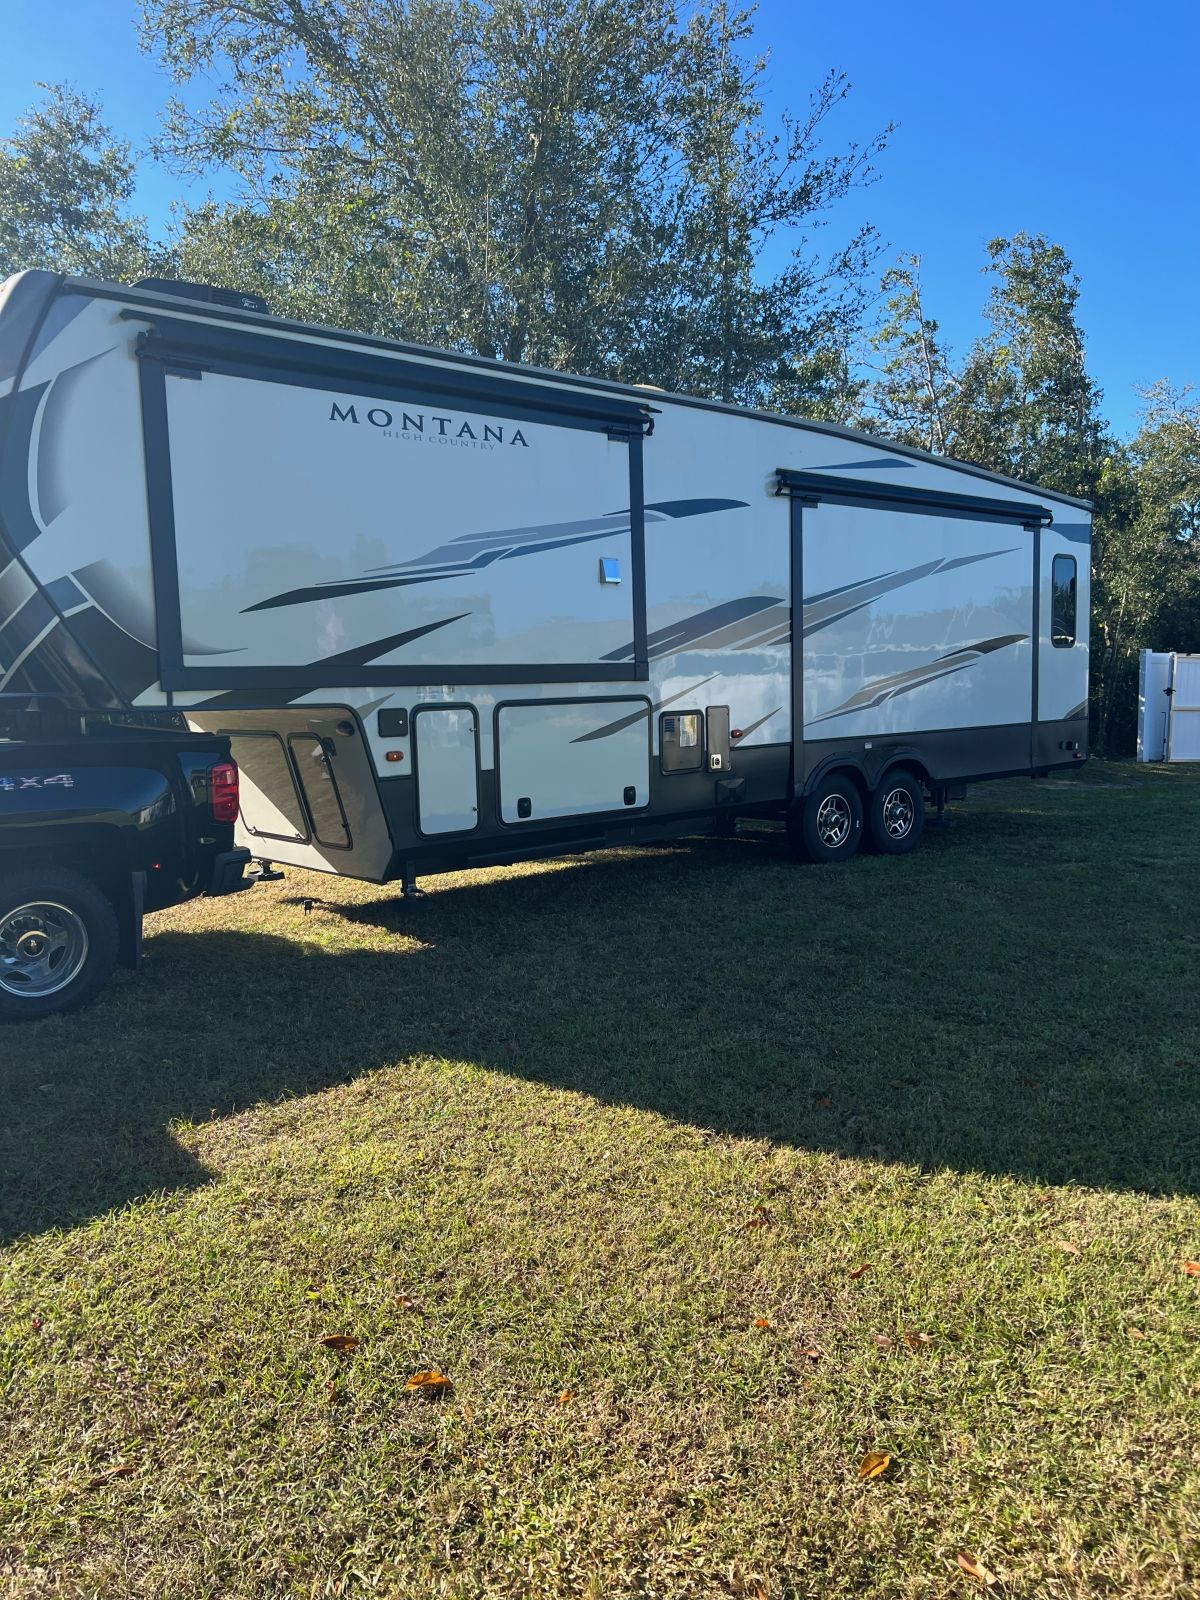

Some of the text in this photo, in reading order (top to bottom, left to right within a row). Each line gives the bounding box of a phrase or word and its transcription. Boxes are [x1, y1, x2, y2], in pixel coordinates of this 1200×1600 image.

[329, 402, 530, 447] MONTANA
[383, 429, 496, 451] HIGH COUNTRY
